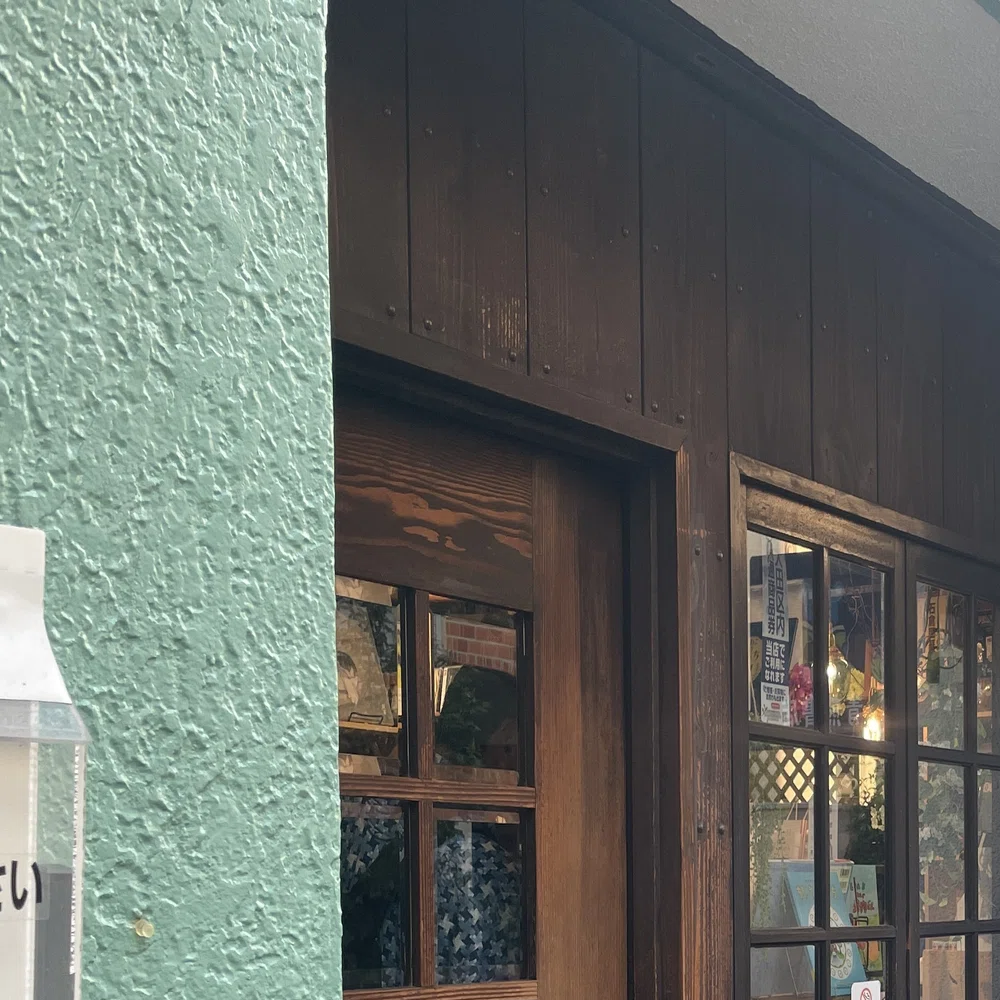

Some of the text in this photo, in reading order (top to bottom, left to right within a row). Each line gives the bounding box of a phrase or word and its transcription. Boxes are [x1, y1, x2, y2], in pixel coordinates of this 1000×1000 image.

[766, 640, 785, 658] 当店で
[0, 860, 42, 910] い
